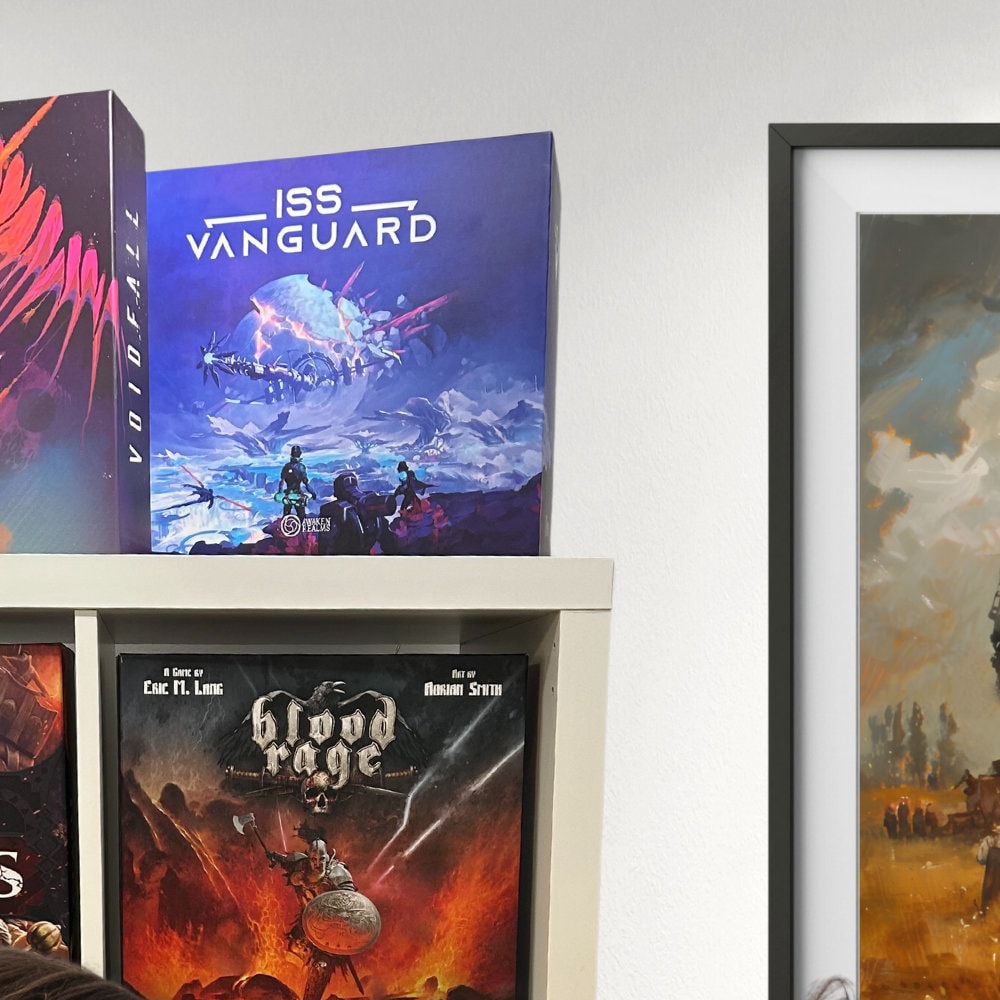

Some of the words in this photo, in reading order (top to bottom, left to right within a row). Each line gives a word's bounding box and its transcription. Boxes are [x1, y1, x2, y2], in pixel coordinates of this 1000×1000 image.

[276, 184, 342, 218] ISS
[186, 214, 437, 261] VANGUARD
[125, 209, 142, 464] VOIDFALL
[173, 680, 190, 695] M.
[252, 696, 396, 750] blood
[264, 739, 382, 789] rage
